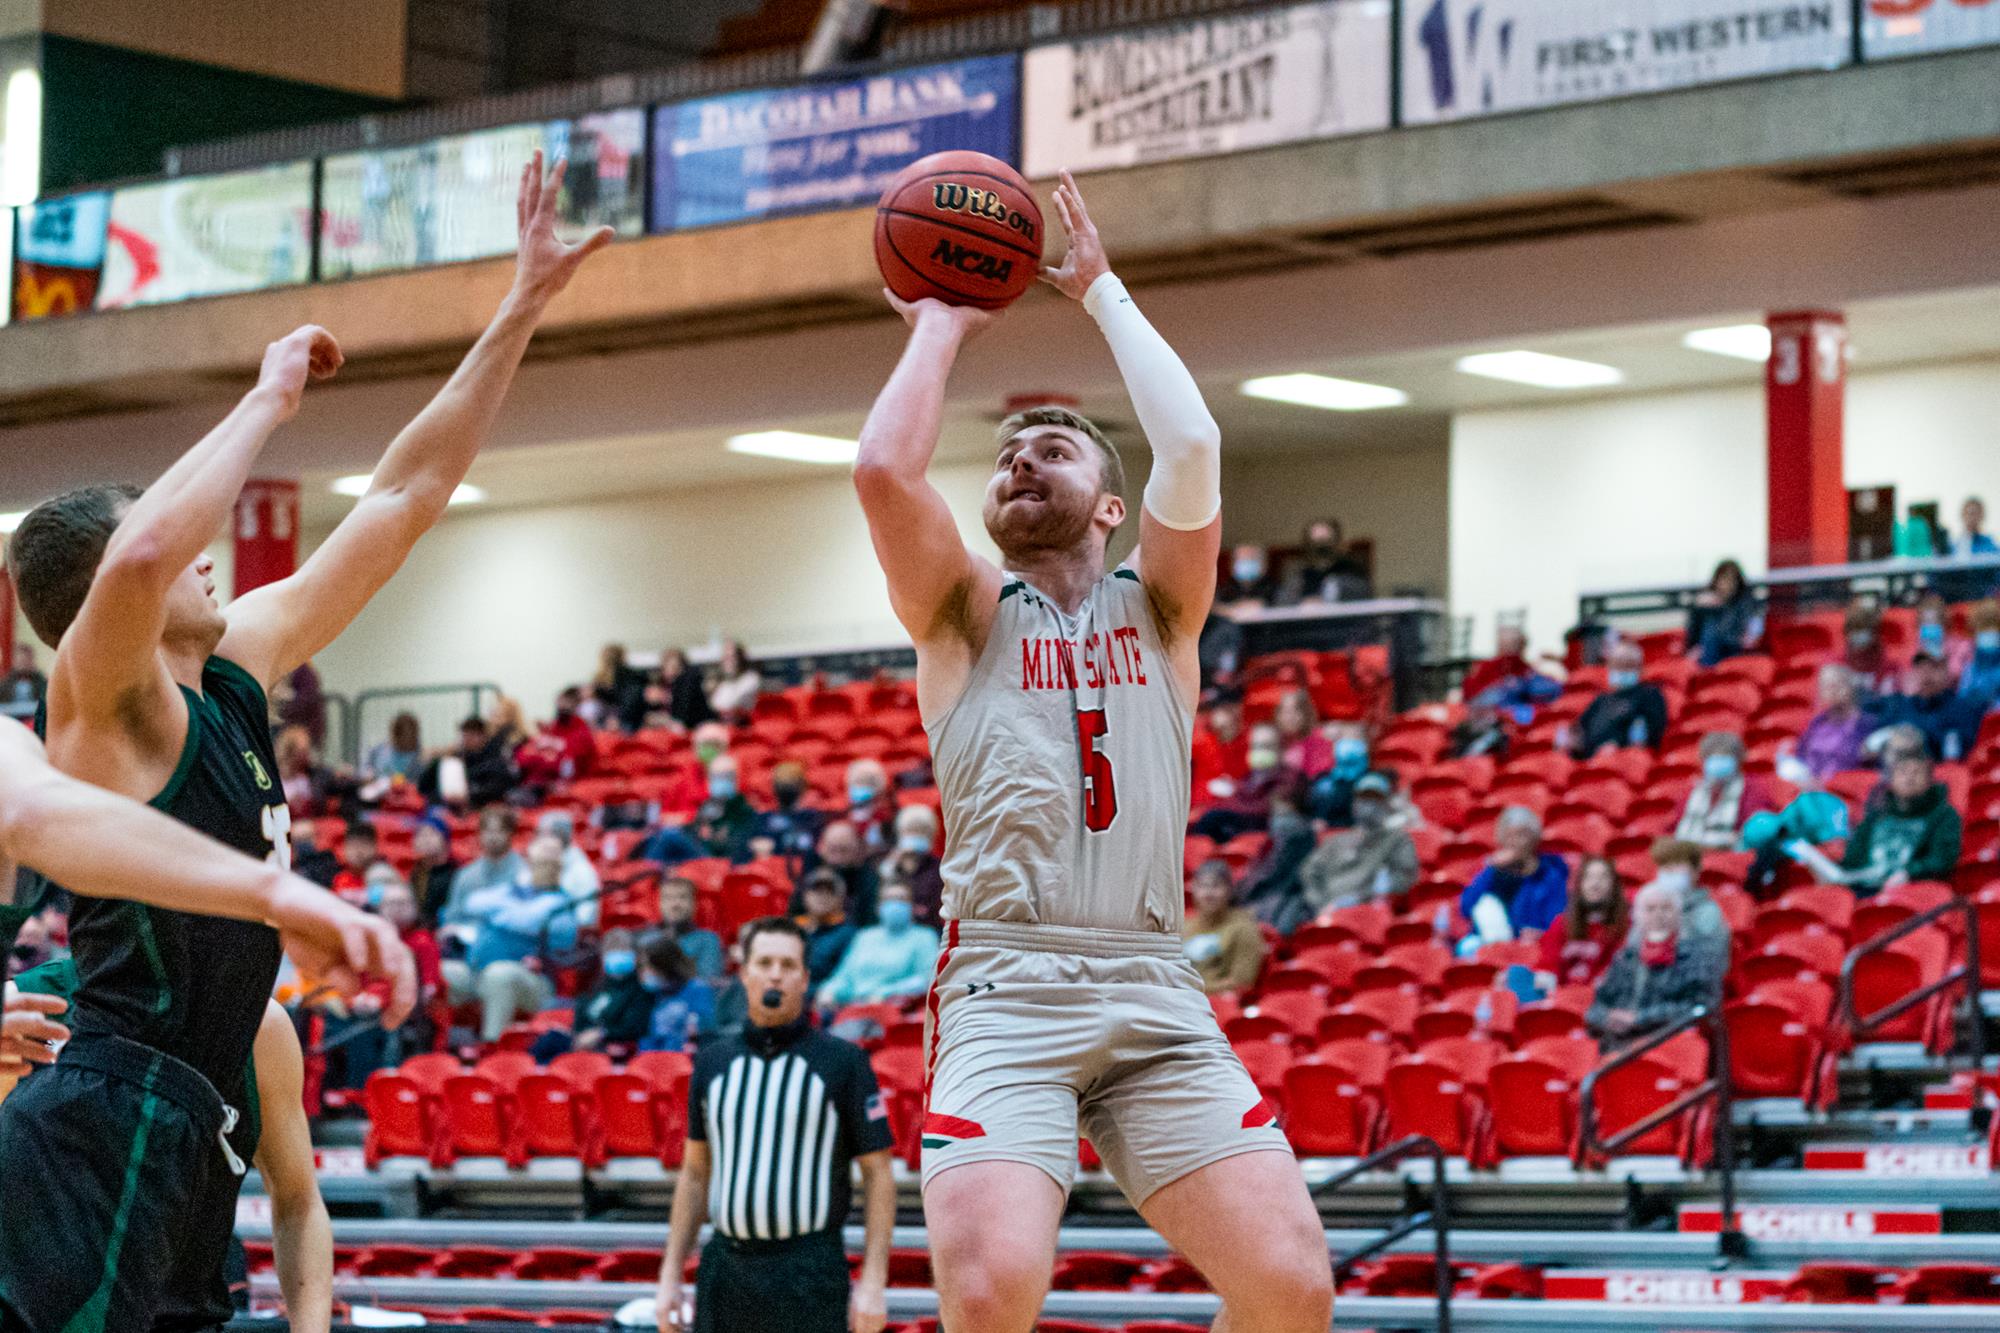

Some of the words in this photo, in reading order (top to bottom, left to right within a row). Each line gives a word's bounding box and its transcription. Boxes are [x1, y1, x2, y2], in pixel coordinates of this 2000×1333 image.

[1536, 29, 1637, 73] FIRST
[1649, 3, 1831, 55] WESTERN
[866, 72, 965, 118] BANK
[933, 183, 1034, 241] Wilson
[930, 239, 1013, 283] NCAA
[1076, 707, 1121, 835] 5
[1741, 1207, 1874, 1238] SCHEELS
[1605, 1273, 1743, 1304] SCHEELS
